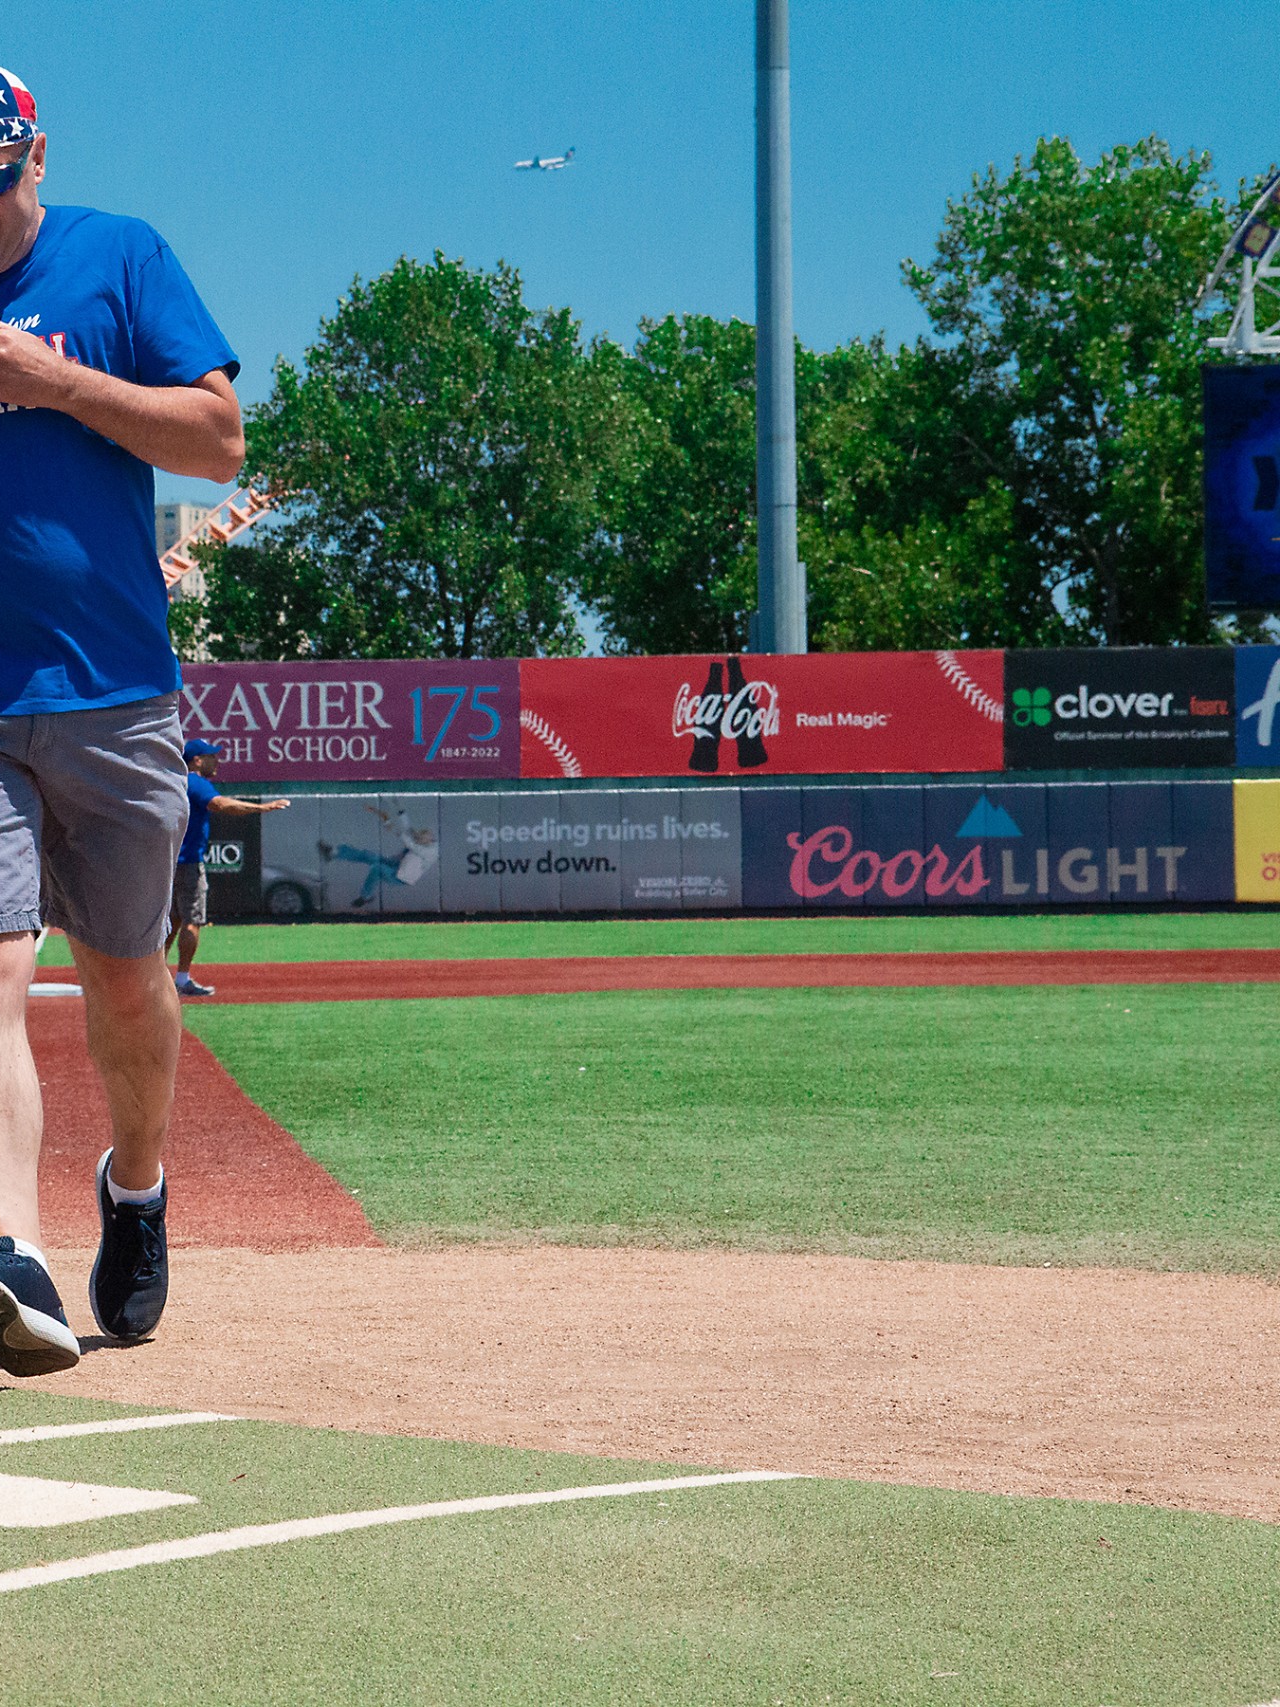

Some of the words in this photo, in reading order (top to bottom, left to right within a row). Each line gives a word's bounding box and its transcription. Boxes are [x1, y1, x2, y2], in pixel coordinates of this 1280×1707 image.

[181, 681, 393, 732] XAVIER
[672, 681, 780, 739] Coca-Cola
[1054, 685, 1174, 719] clover
[409, 686, 502, 762] 175
[796, 713, 833, 727] Real
[837, 711, 888, 729] Magic
[267, 735, 388, 763] SCHOOL
[440, 747, 501, 759] 1847-2022
[466, 817, 590, 849] Speeding
[595, 818, 658, 841] ruins
[663, 815, 730, 839] lives.
[466, 852, 531, 875] Slow
[536, 850, 617, 873] down.
[786, 825, 991, 898] Coors
[1002, 846, 1188, 896] LIGHT
